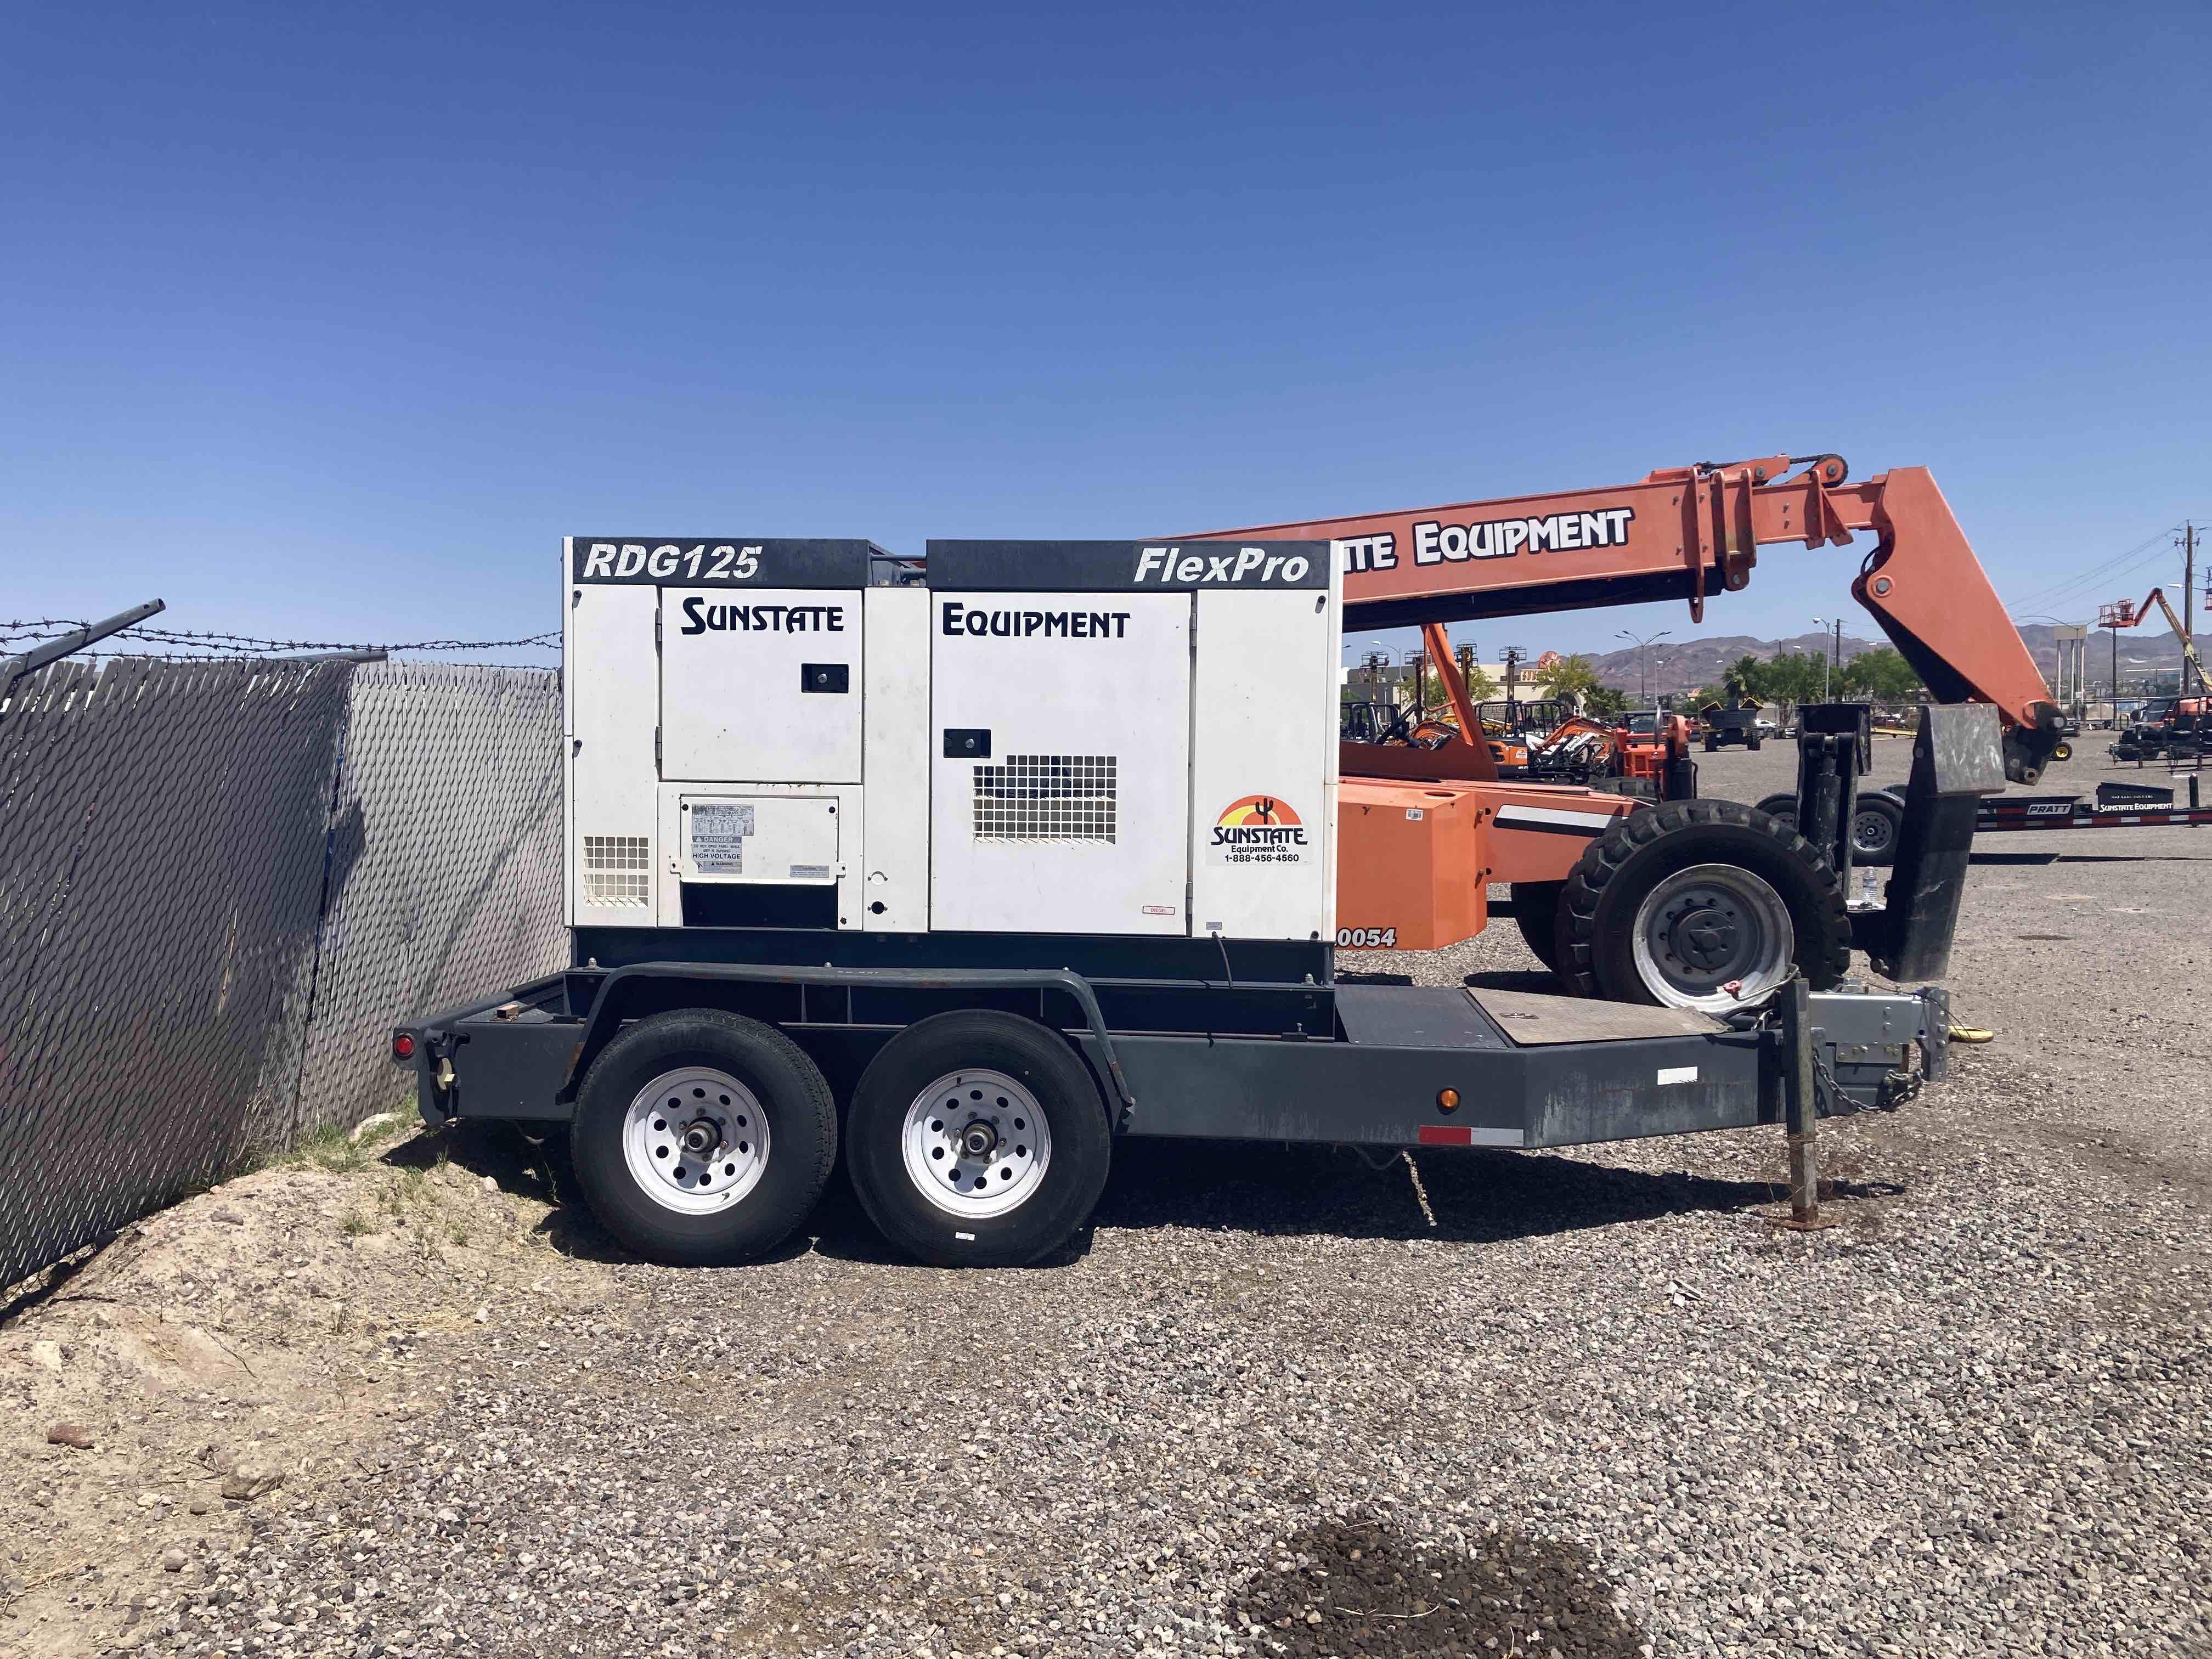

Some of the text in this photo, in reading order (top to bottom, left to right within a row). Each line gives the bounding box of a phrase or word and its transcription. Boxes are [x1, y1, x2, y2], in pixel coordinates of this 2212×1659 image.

[1414, 509, 1633, 563] EQUIPMENT
[583, 543, 763, 579] RDG125
[1133, 547, 1309, 583] FlexPro
[681, 597, 1131, 638] SUNSTATE EQUIPMENT
[2099, 804, 2134, 812] SUNSTATE
[1211, 826, 1308, 845] SUNSTATE
[1225, 854, 1299, 862] 1-888-456-4560
[1231, 845, 1276, 854] Equipment
[1334, 929, 1396, 947] 0054
